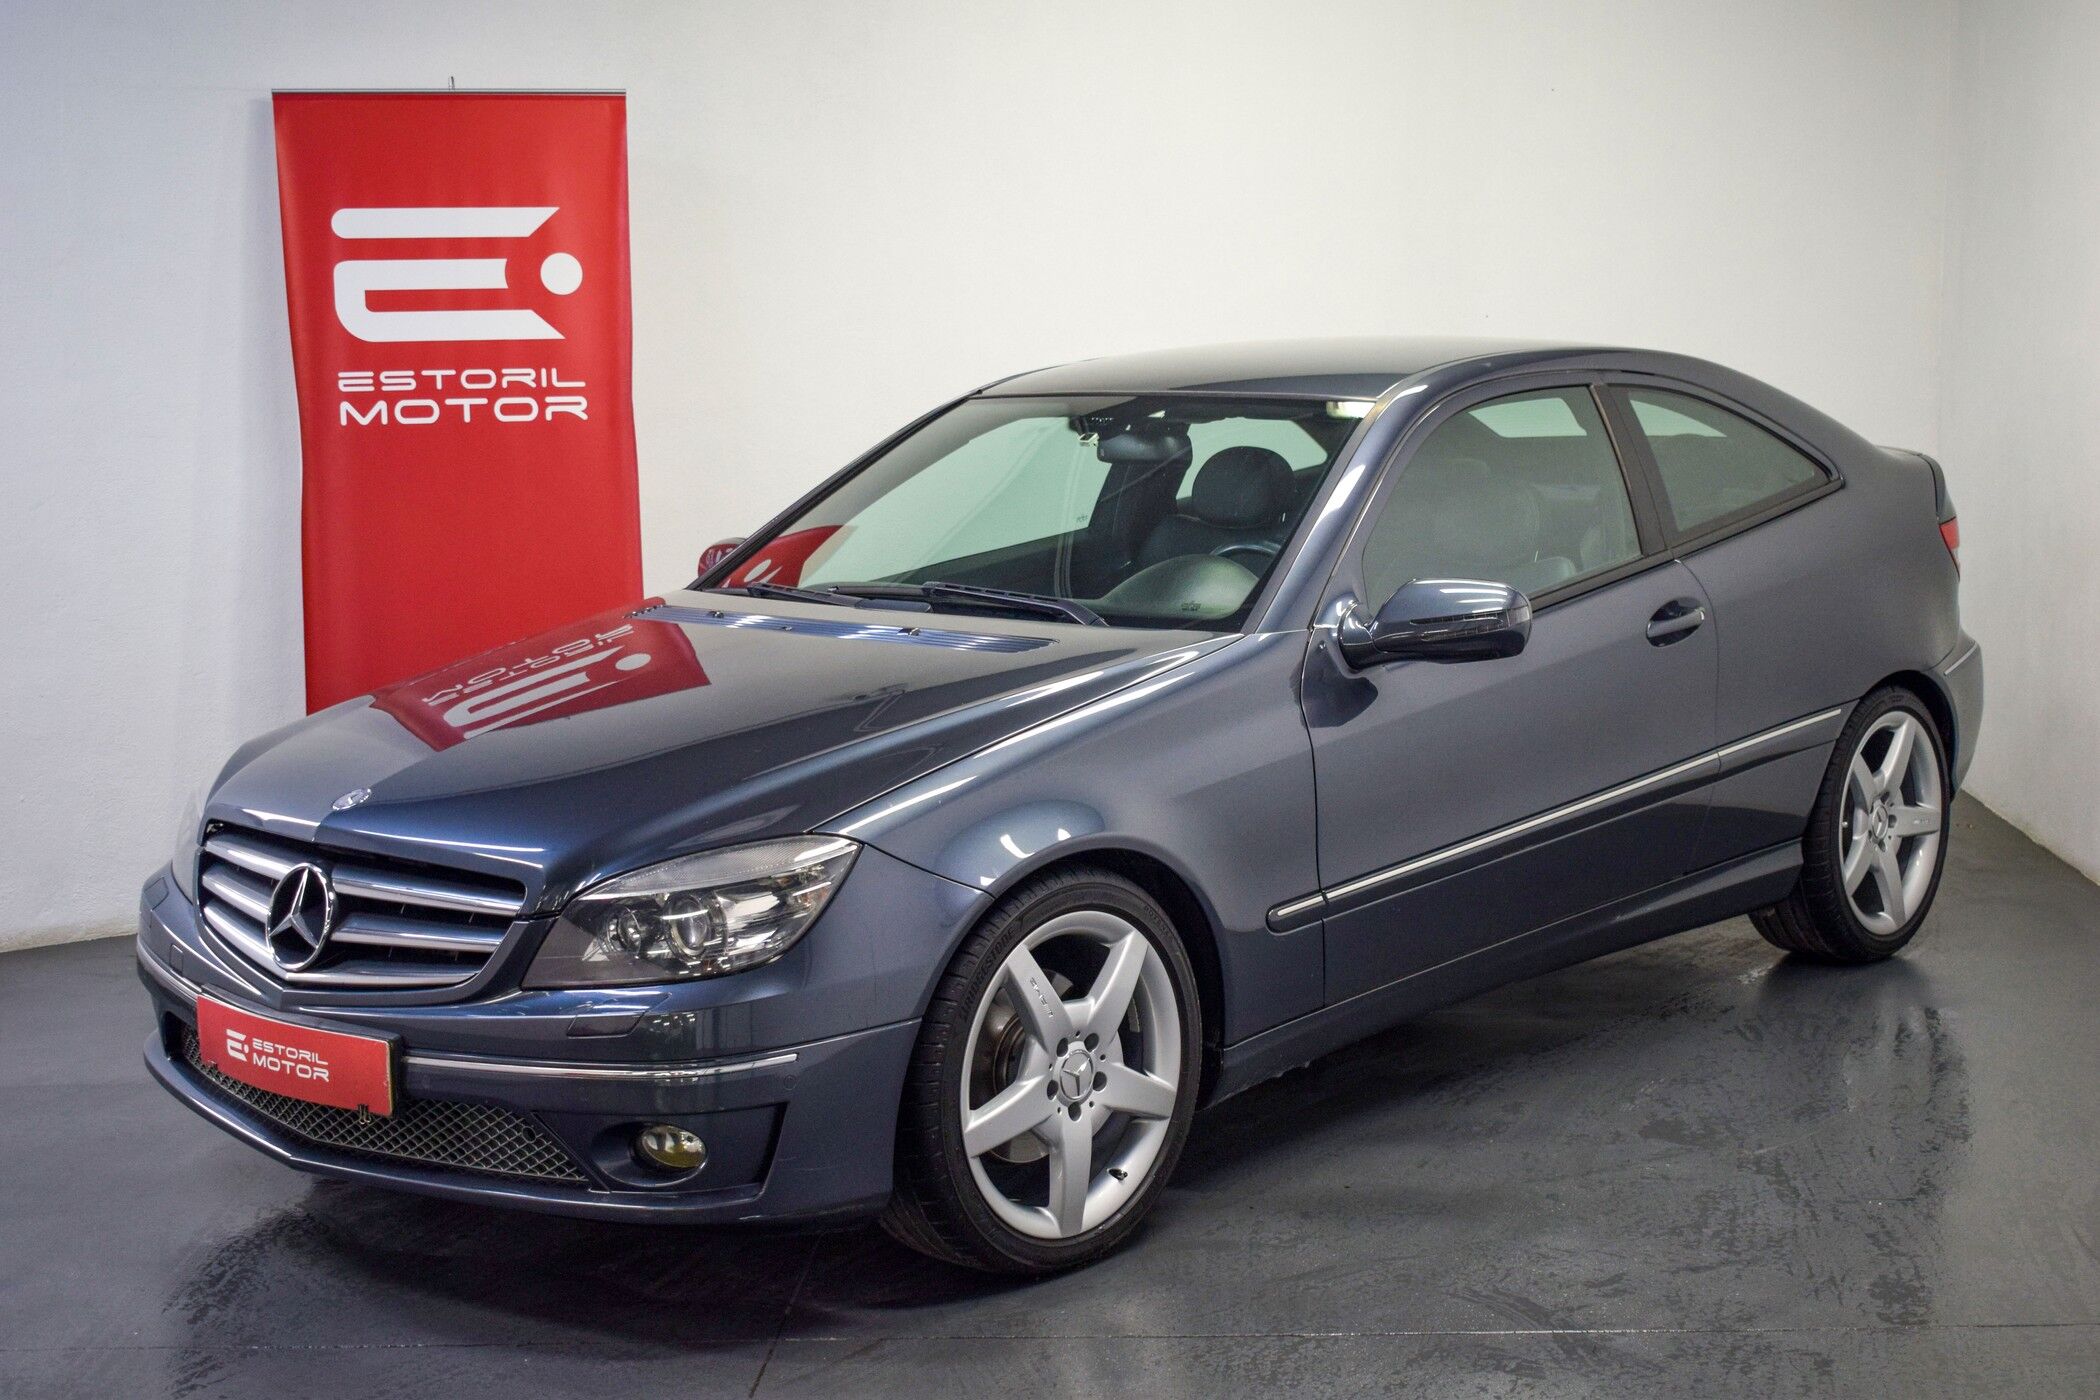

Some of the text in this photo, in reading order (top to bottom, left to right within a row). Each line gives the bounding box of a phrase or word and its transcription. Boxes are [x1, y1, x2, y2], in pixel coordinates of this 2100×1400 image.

[337, 368, 587, 392] ESTORIL
[340, 396, 588, 426] MOTOR
[252, 1038, 329, 1065] ESTORIL
[252, 1052, 329, 1082] MOTOR
